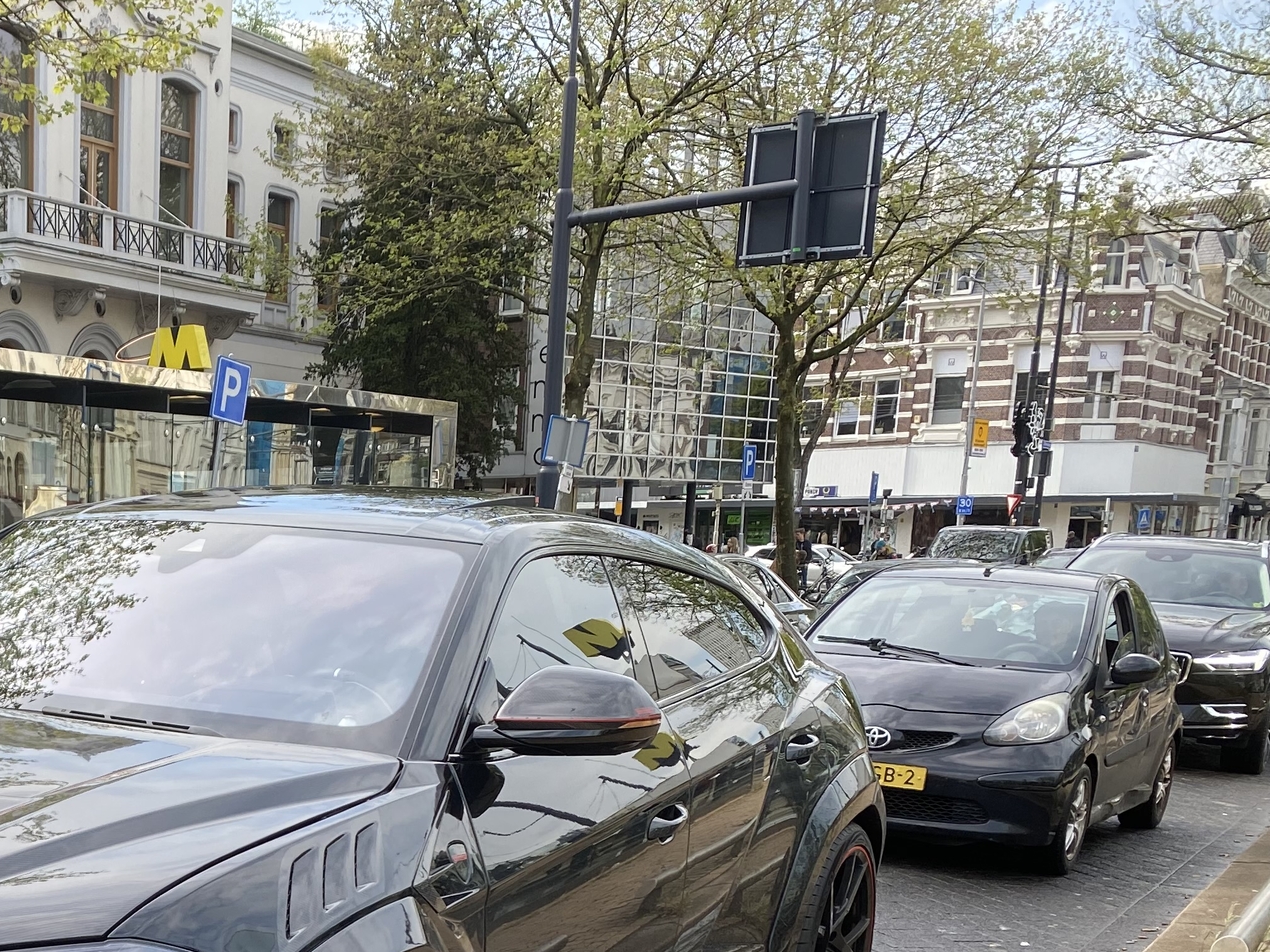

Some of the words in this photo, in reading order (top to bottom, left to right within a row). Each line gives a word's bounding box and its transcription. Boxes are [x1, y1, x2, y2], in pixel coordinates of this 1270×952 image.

[148, 325, 212, 370] M
[220, 366, 242, 412] P
[746, 449, 754, 476] P
[959, 498, 972, 507] 30
